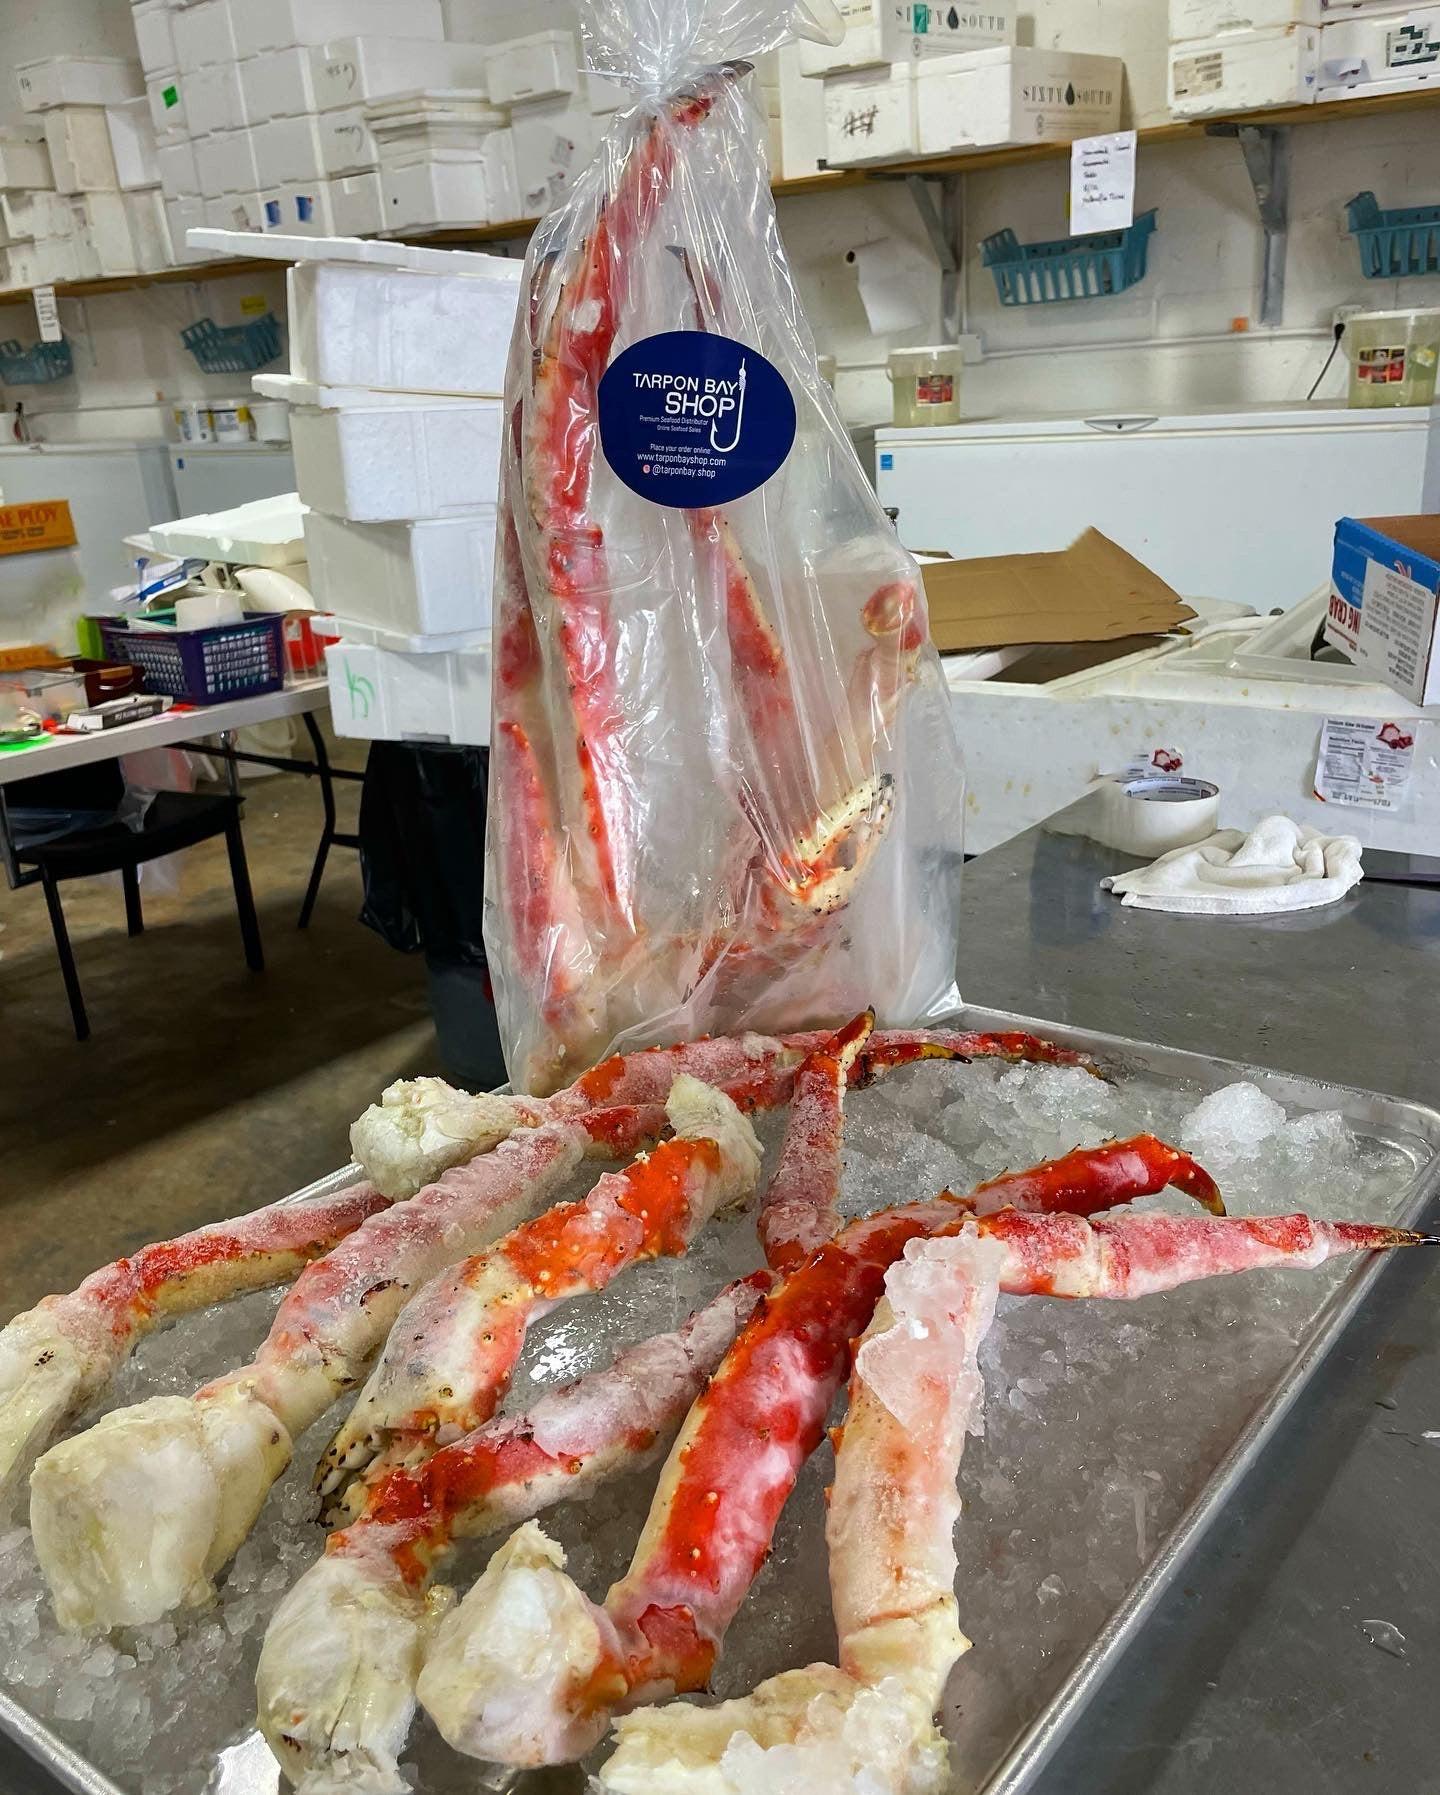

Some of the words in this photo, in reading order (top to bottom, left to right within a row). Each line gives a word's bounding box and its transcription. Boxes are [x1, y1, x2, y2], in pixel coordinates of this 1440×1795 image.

[895, 6, 943, 26] SITY
[961, 14, 1006, 31] SOUTH
[1023, 86, 1063, 104] SIXTY
[1076, 88, 1113, 105] SOUTH
[633, 373, 699, 392] TARPON
[704, 378, 738, 396] BAY
[665, 391, 736, 418] SHOP
[660, 416, 681, 424] Seafood
[681, 417, 709, 426] Distributor
[650, 443, 665, 451] Place
[678, 445, 692, 453] order
[693, 446, 711, 455] online
[637, 453, 726, 467] www.tarponbayshop.com
[1329, 594, 1347, 625] CRAB
